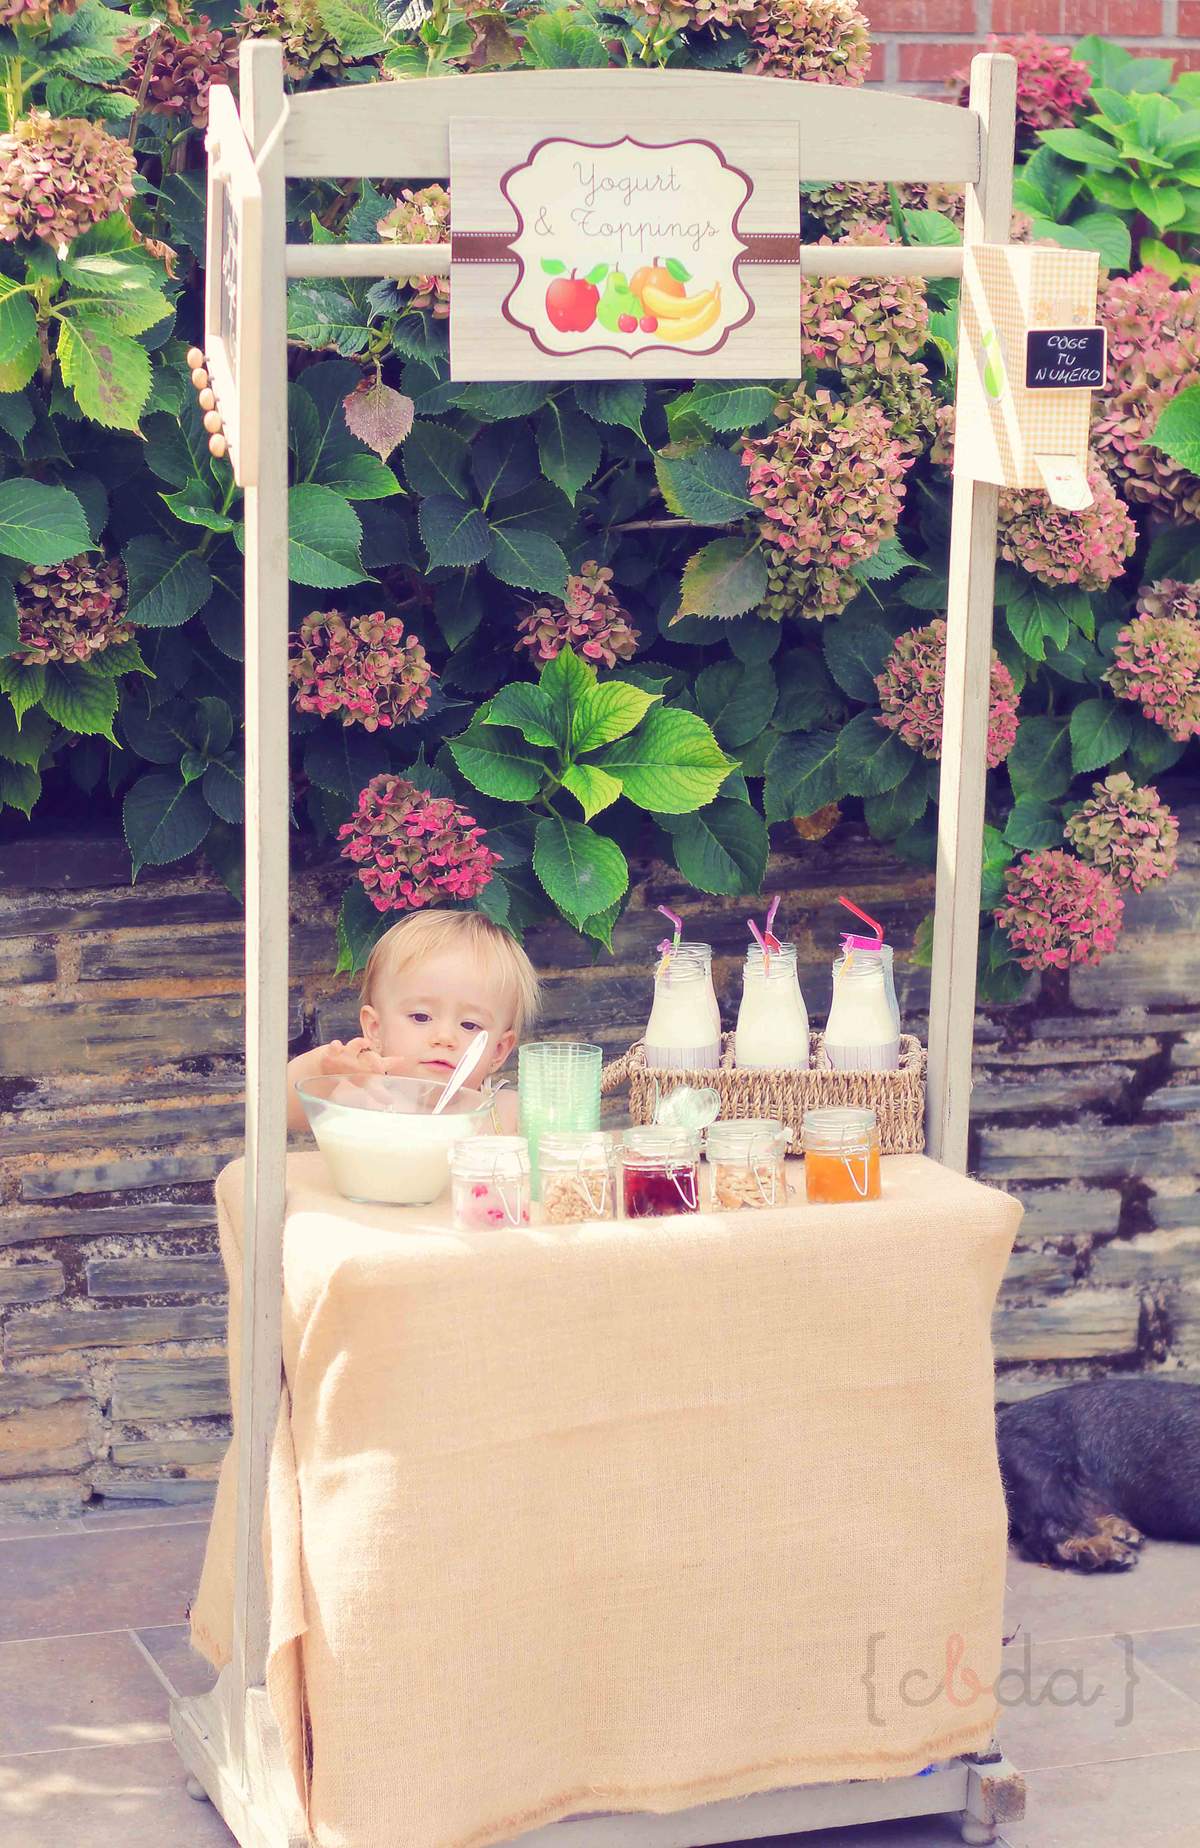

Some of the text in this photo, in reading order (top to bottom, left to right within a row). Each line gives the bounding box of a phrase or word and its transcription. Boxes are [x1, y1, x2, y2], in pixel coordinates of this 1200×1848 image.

[573, 161, 681, 206] Yogurt
[534, 206, 720, 252] & Toppings
[1047, 335, 1089, 350] COGE
[1057, 352, 1076, 366] TU
